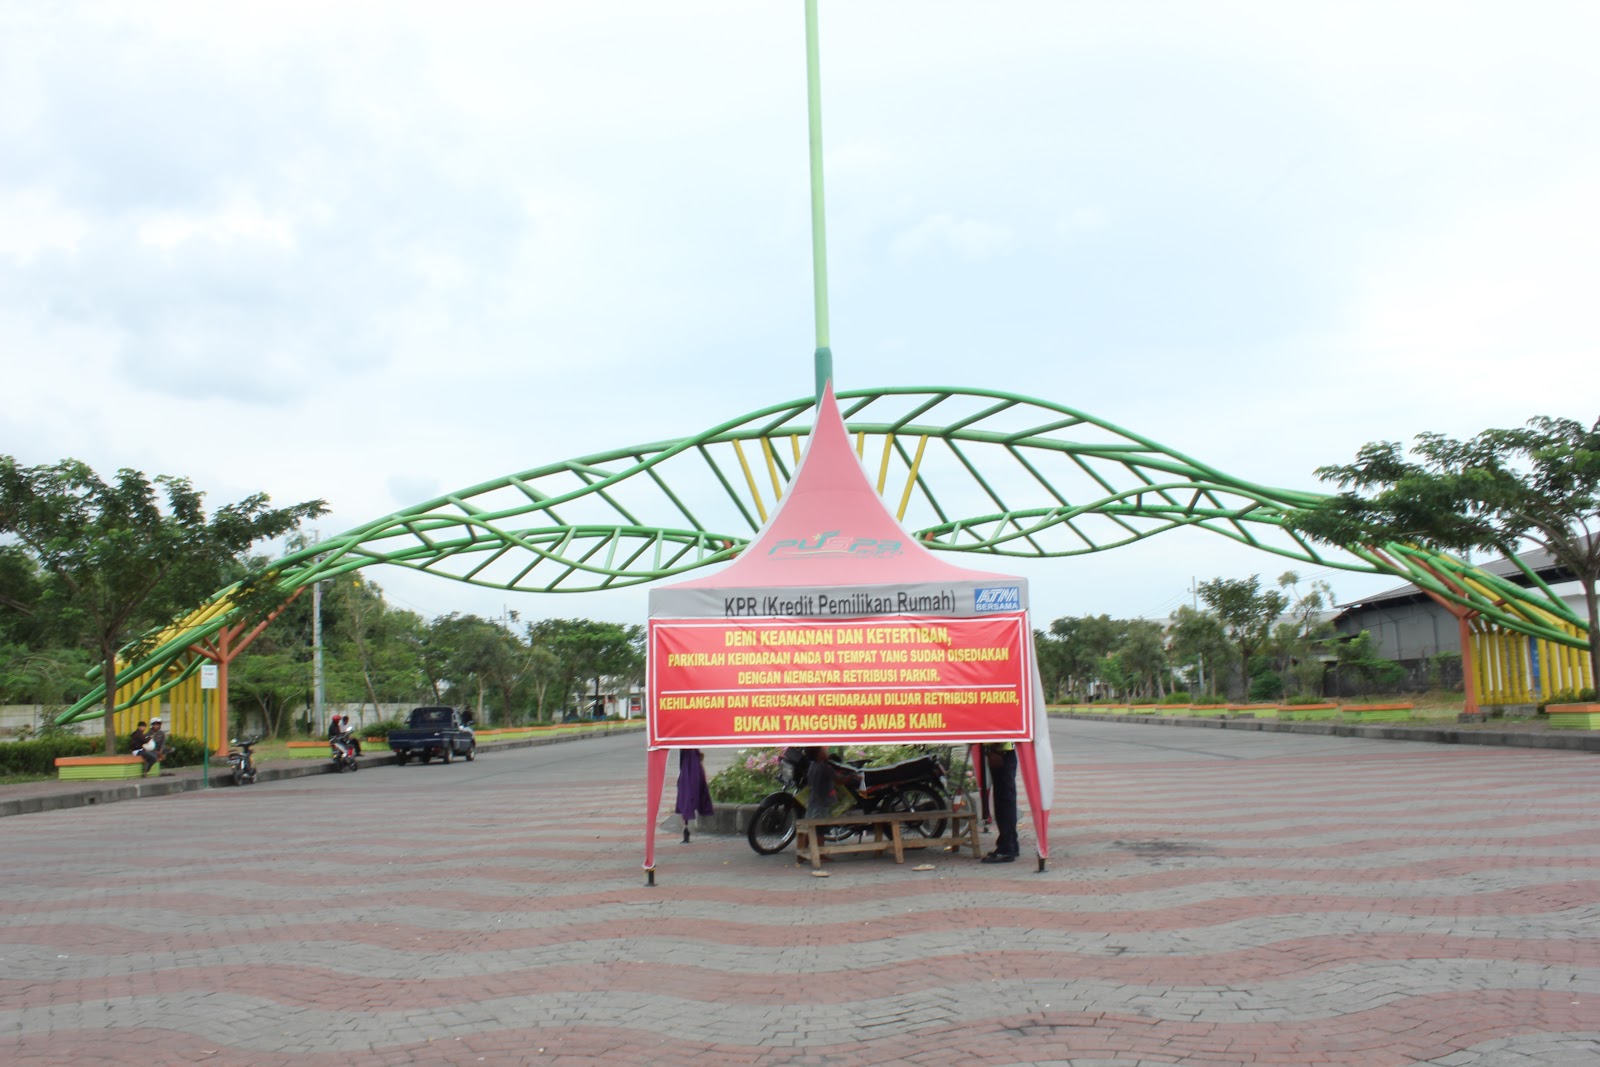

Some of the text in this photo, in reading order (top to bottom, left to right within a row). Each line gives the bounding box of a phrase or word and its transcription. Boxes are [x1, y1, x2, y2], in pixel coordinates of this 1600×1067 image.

[725, 590, 956, 616] KPR (Kredit Pemilikan Rumah)
[975, 588, 1018, 602] ATM
[975, 603, 1019, 611] BERSAMA
[725, 627, 952, 646] DEMI KEAMANAN DAN KETERTIBAN,
[668, 648, 1009, 667] PARKIRLAH KENDARAAN ANDA DI TEMPAT YANG SUDAH DISEDIAKAN
[738, 669, 940, 685] DENGAN MEMBAYAR RETRIBUSI PARKIR.
[659, 691, 1019, 710] KEHILANGAN DAN KERUSAKAN KENDARAAN DILUAR RETRIBUSI PARKIR,
[734, 712, 946, 732] BUKAN TANGGUNG JAWAB KAMI.
